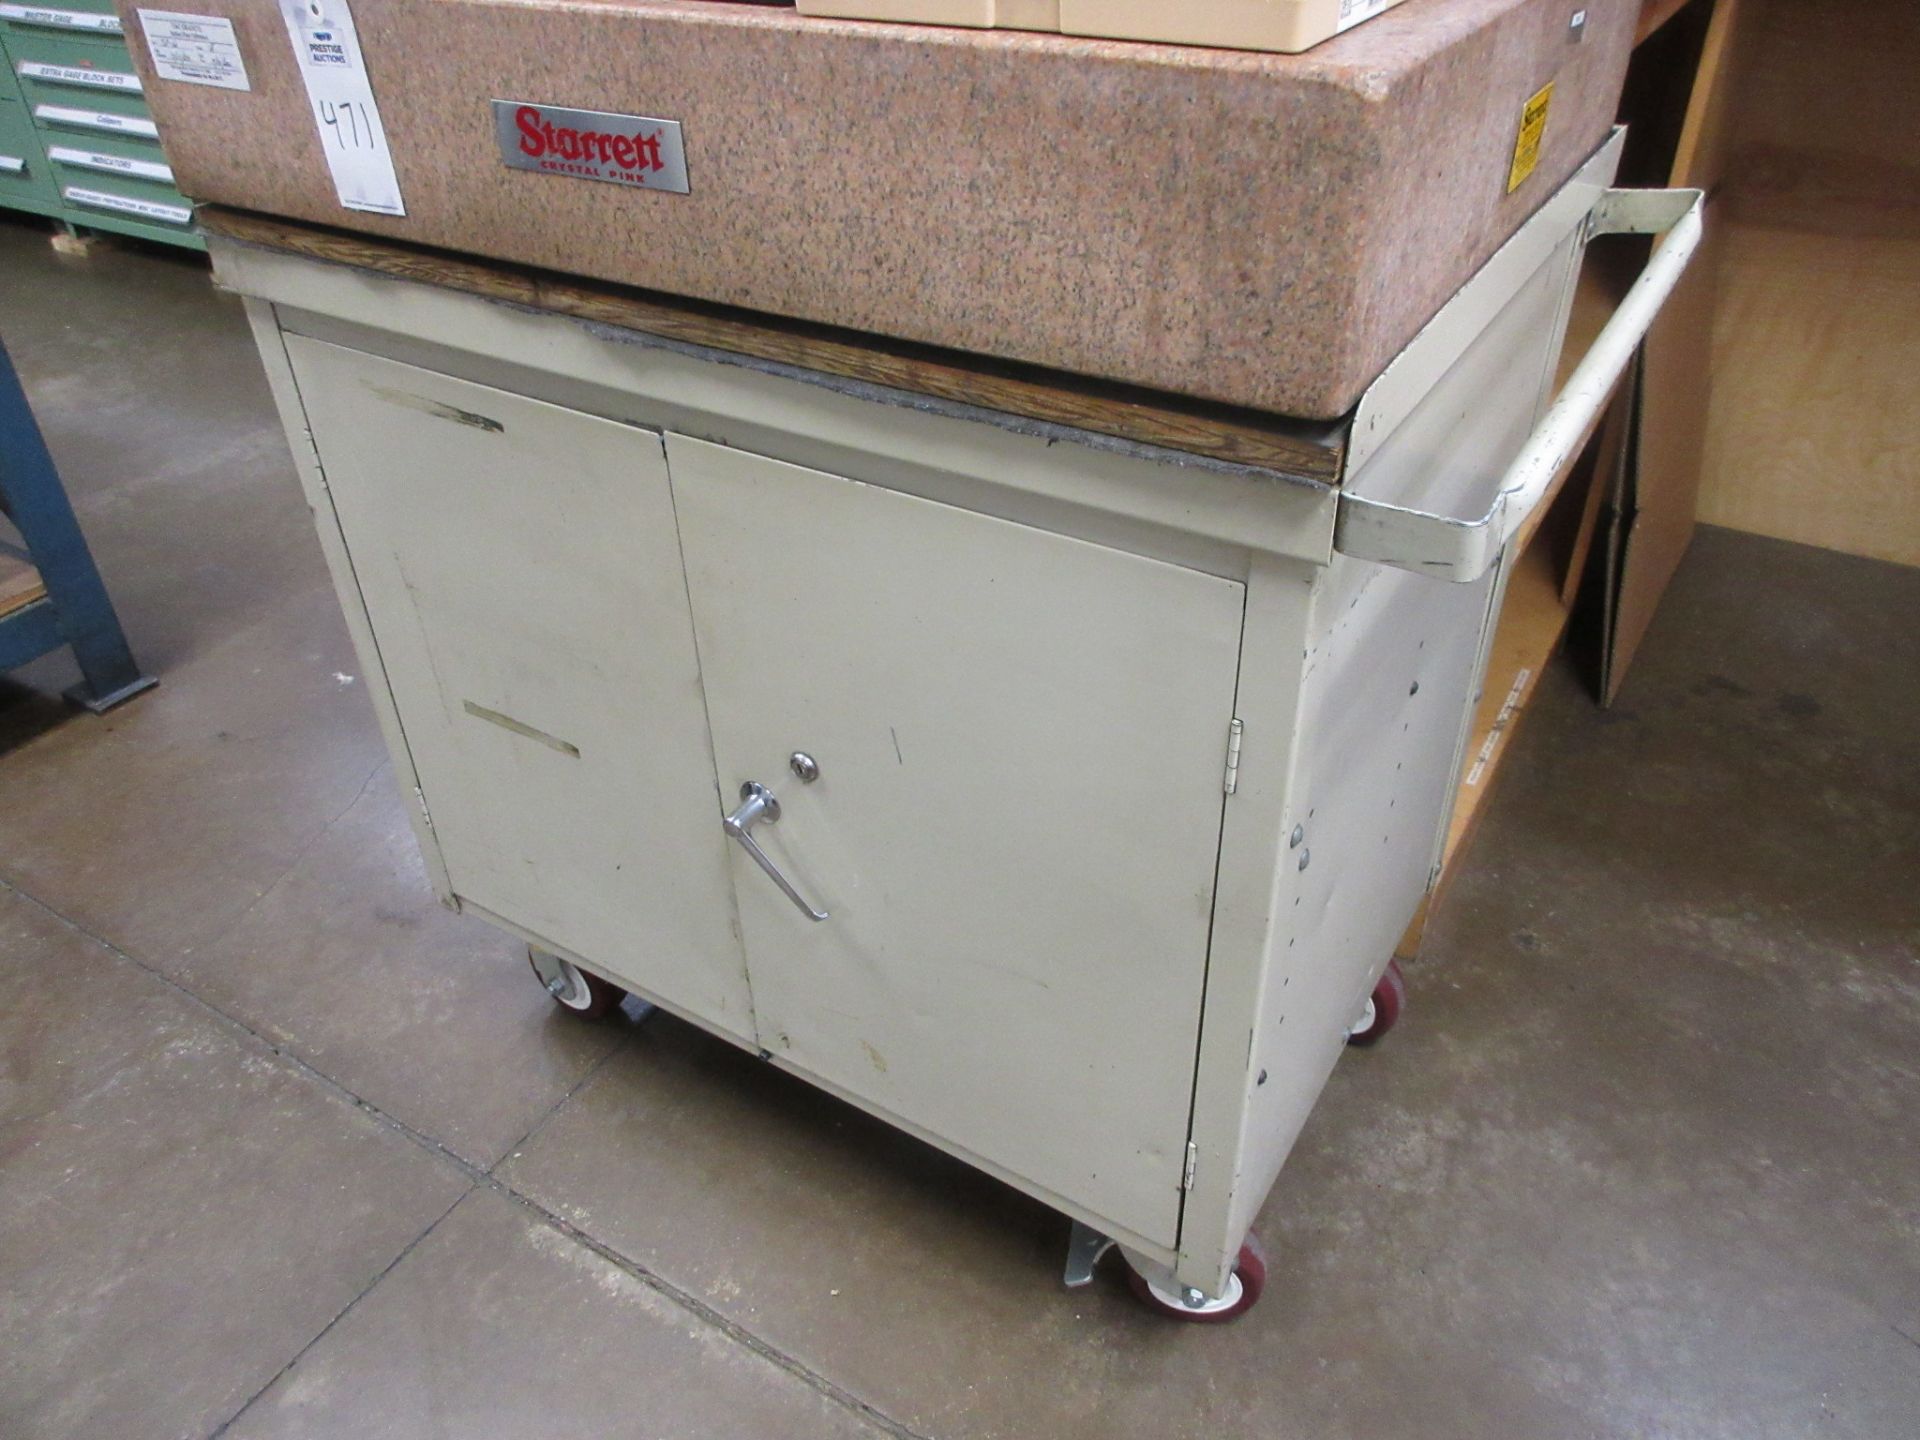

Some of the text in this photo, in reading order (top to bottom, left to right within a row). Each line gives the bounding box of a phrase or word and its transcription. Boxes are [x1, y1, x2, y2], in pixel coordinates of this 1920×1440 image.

[99, 18, 121, 30] BLOC
[308, 43, 343, 54] PRESTIGE
[313, 53, 346, 64] AUCTIONS
[40, 67, 62, 77] EXTRA
[82, 73, 105, 82] BLOCK
[107, 76, 124, 84] SETS
[319, 99, 375, 151] 471
[514, 105, 665, 173] Starrett
[92, 156, 132, 169] INDICATORS
[540, 160, 646, 184] CRYSTAL PINK
